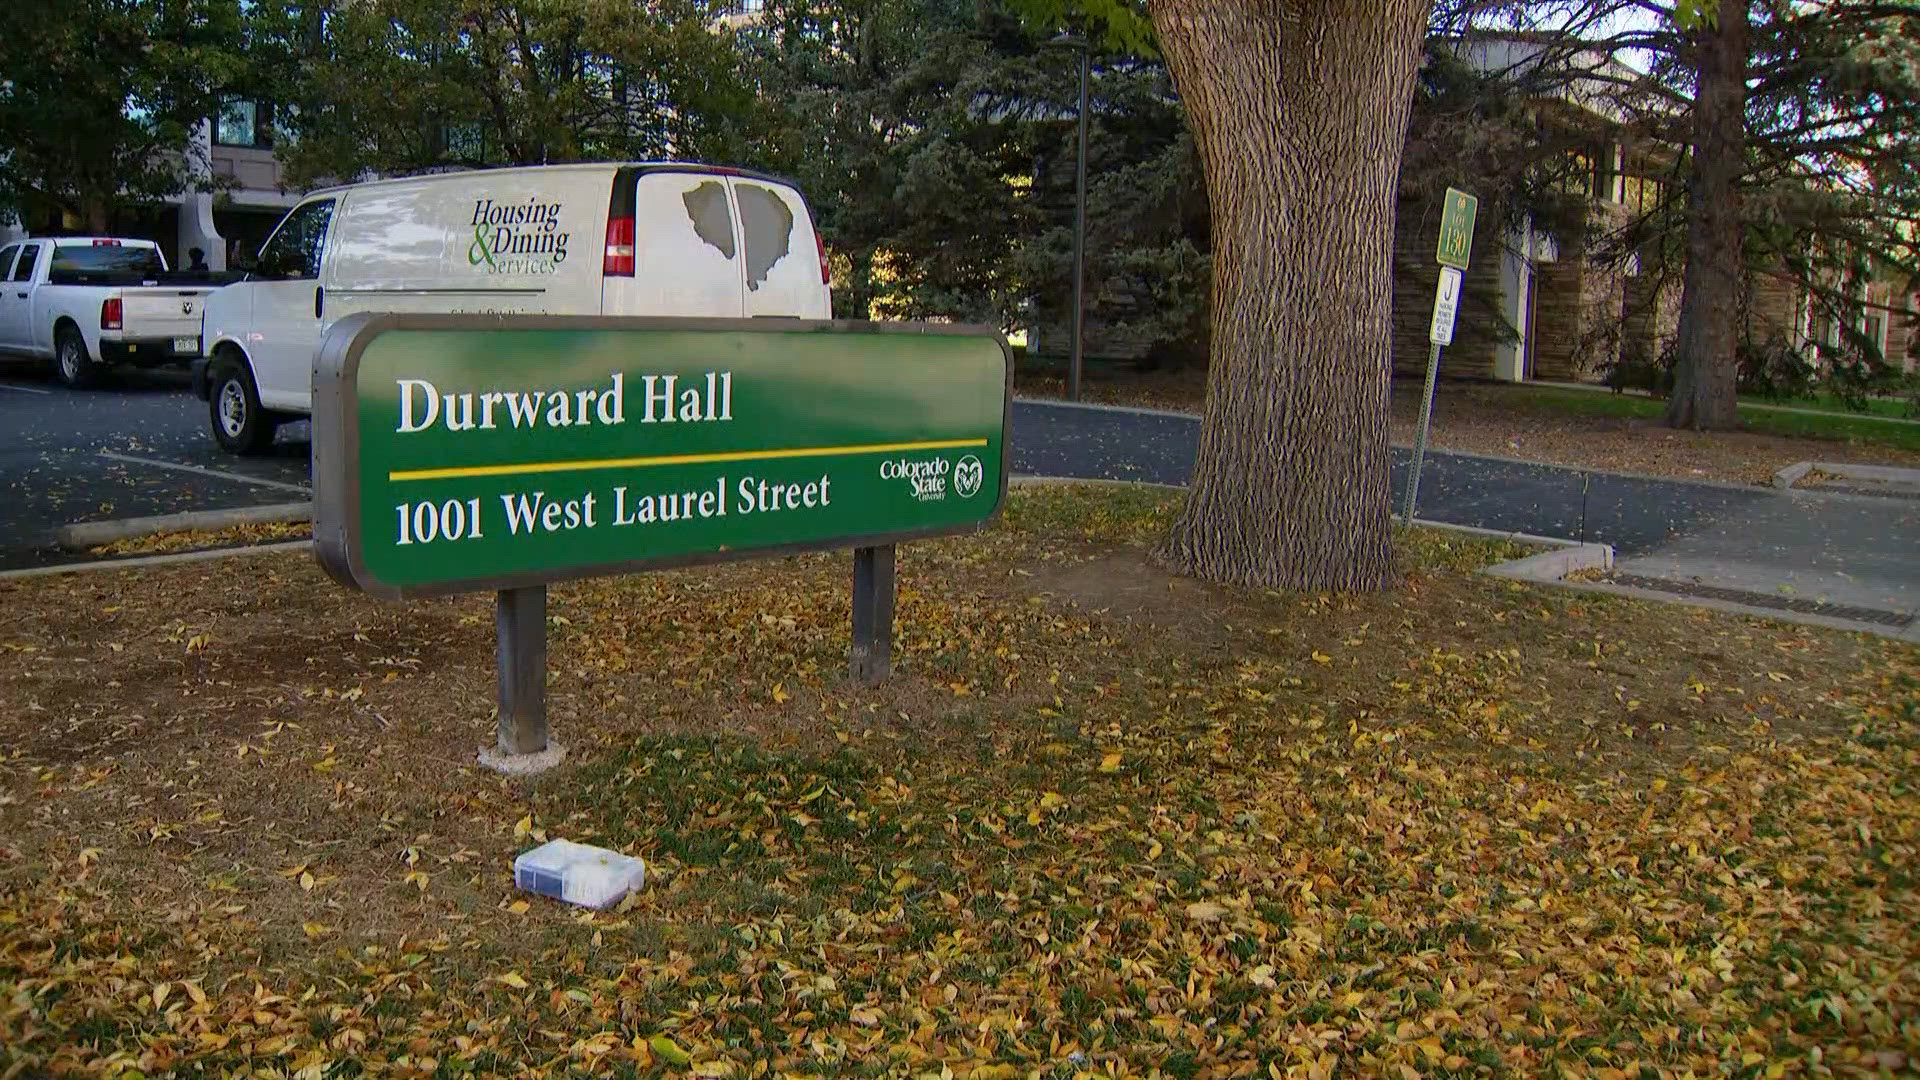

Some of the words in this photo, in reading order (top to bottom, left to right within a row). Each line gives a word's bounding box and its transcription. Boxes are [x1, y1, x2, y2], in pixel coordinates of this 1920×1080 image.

[471, 197, 561, 232] Housing
[492, 226, 570, 263] Dining
[487, 254, 555, 274] Services
[396, 372, 625, 433] Durward
[640, 371, 733, 423] Hall
[880, 456, 950, 479] Colorado
[910, 473, 946, 497] State
[396, 497, 484, 545] 1001
[500, 491, 597, 535] West
[612, 476, 726, 526] Laurel
[737, 474, 831, 514] Street
